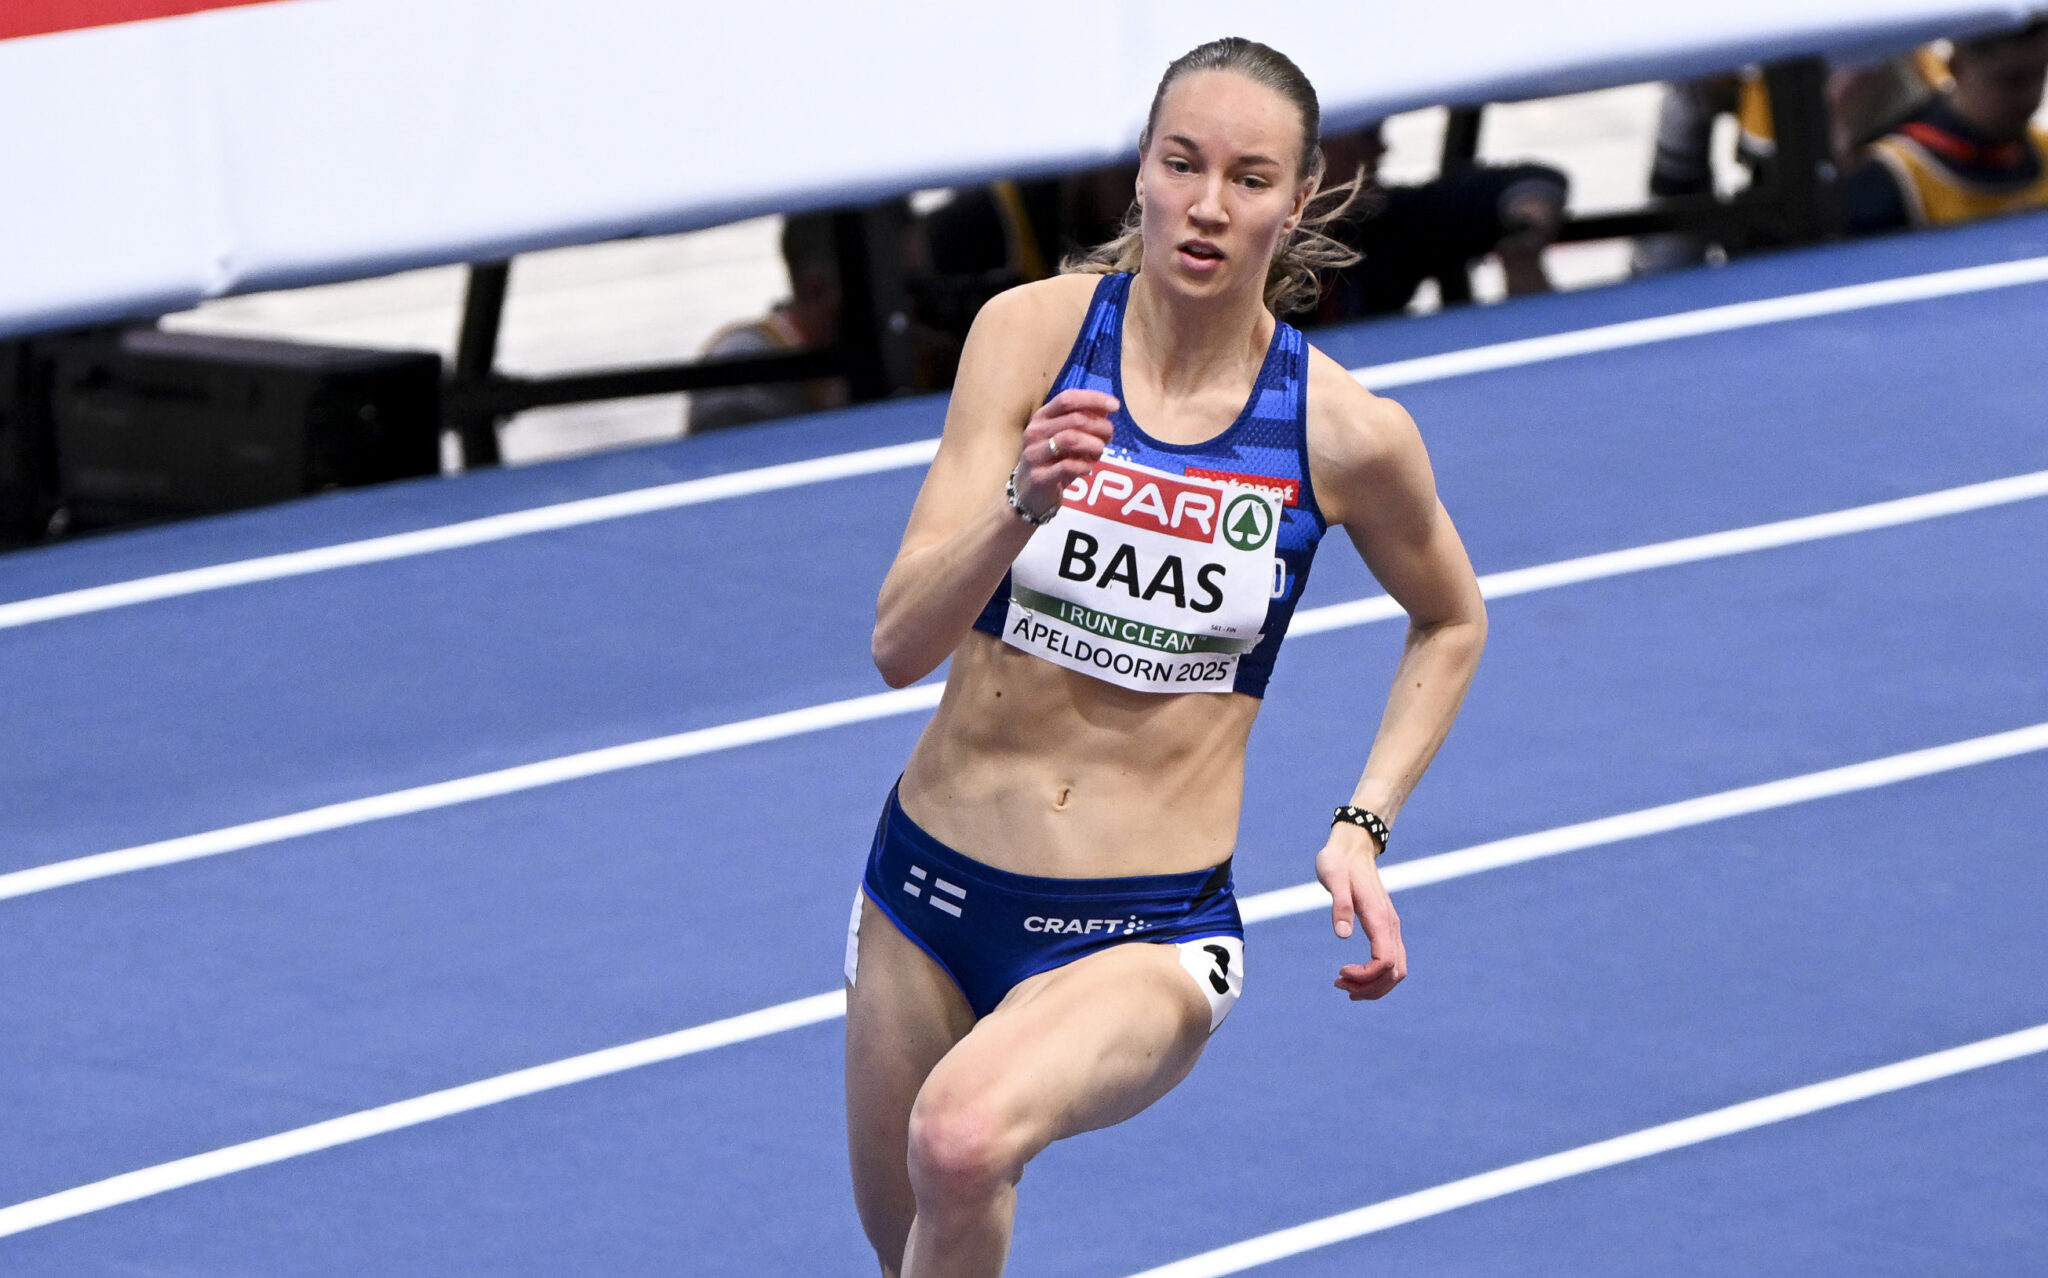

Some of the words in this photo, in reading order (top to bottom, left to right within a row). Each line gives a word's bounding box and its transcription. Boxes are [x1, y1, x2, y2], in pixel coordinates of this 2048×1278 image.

[1062, 470, 1216, 535] SPAR
[1058, 529, 1226, 613] BAAS
[1060, 602, 1066, 618] I
[1070, 606, 1117, 636] RUN
[1013, 617, 1173, 682] APELDOORN
[1175, 661, 1230, 682] 2025
[1023, 916, 1124, 935] CRAFT
[1203, 944, 1230, 995] 3
